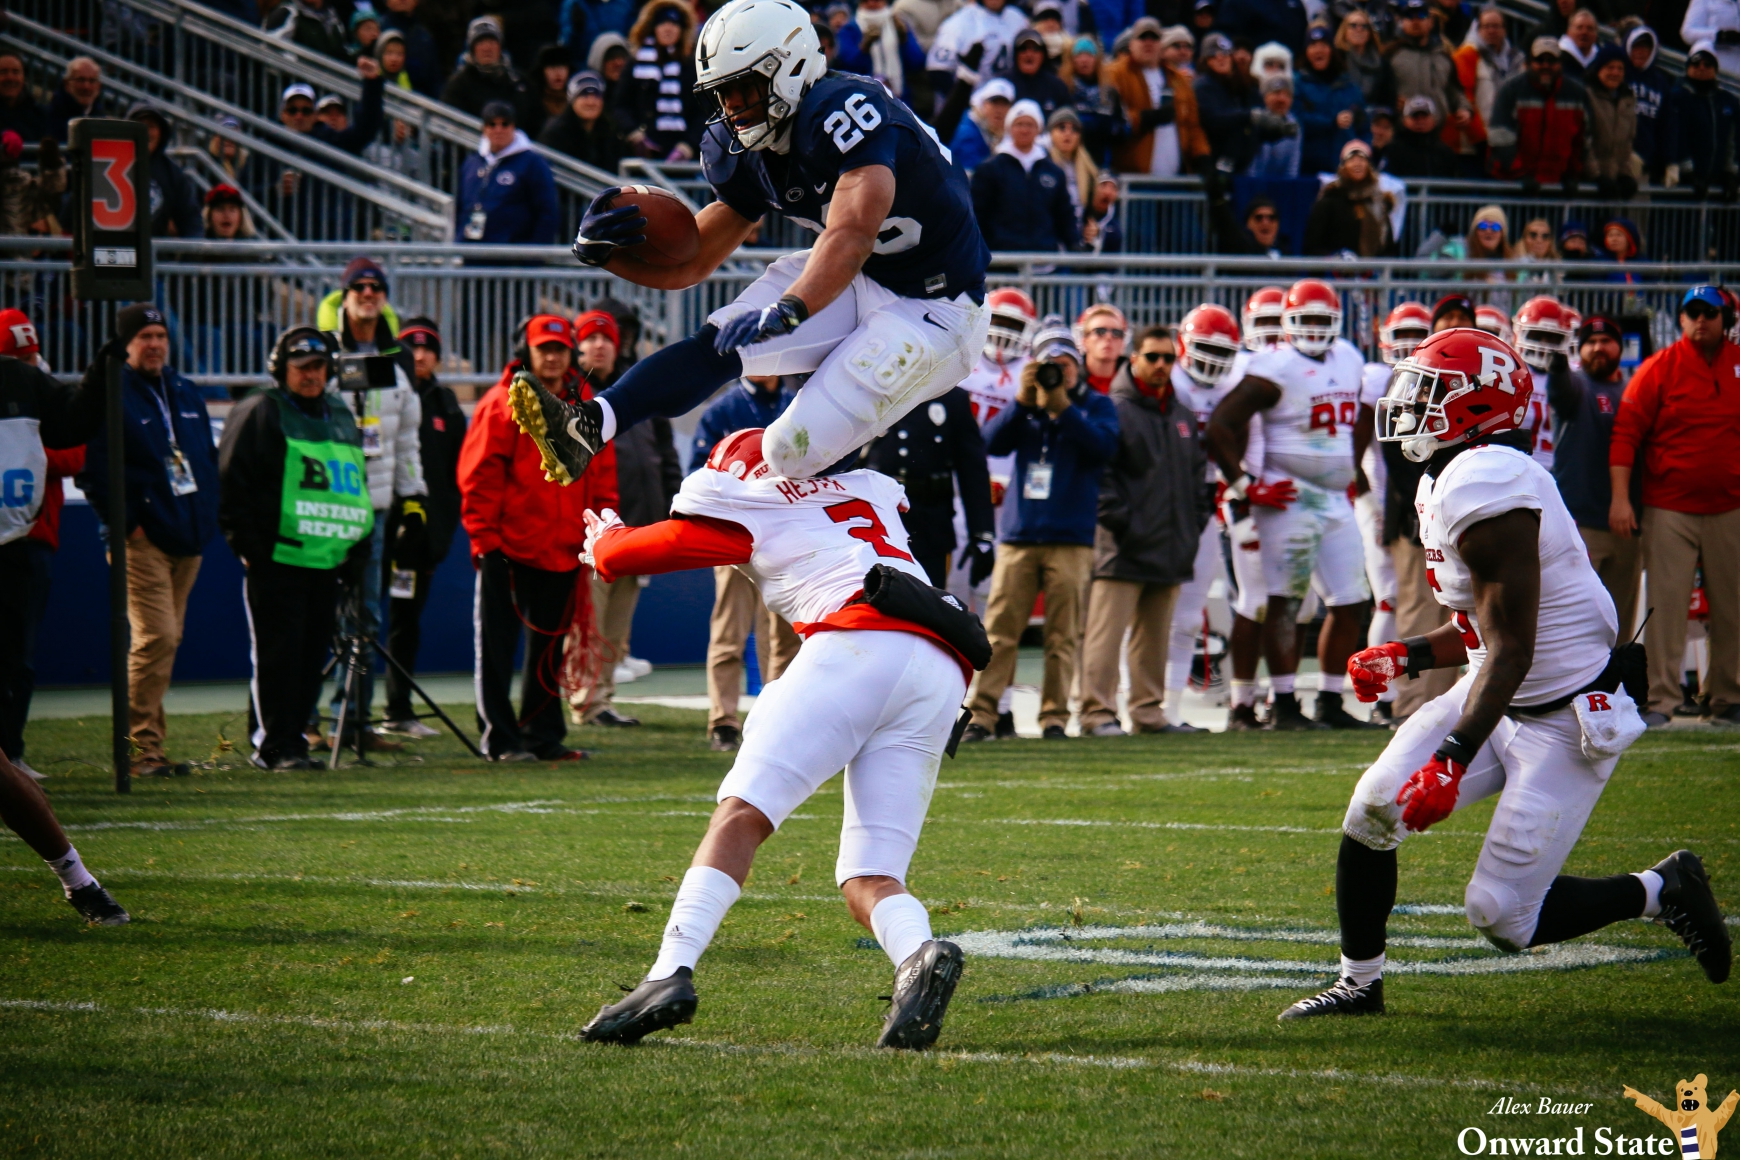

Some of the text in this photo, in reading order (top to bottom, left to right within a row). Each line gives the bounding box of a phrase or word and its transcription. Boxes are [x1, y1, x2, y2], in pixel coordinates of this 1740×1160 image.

[823, 93, 882, 154] 26
[91, 138, 136, 231] 3
[9, 323, 39, 349] R
[850, 338, 923, 389] 26
[1477, 346, 1516, 396] R
[296, 500, 367, 523] INSTANT
[823, 498, 915, 565] 2
[1586, 693, 1612, 712] R
